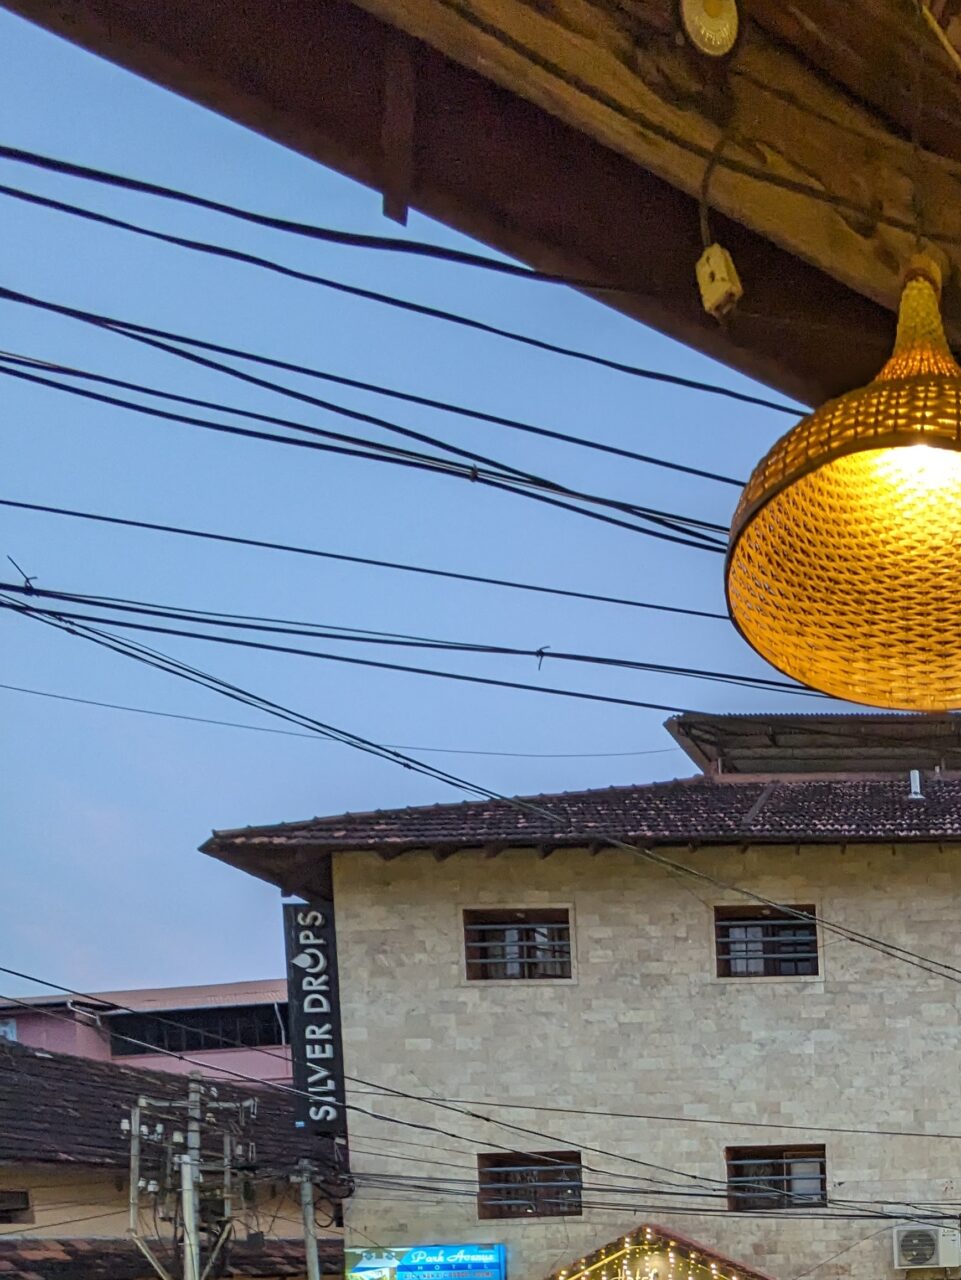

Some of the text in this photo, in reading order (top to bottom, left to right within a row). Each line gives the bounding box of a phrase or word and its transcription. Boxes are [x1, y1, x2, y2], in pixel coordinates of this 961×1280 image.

[290, 910, 337, 1122] SILVER DROPS
[411, 1250, 445, 1263] Park
